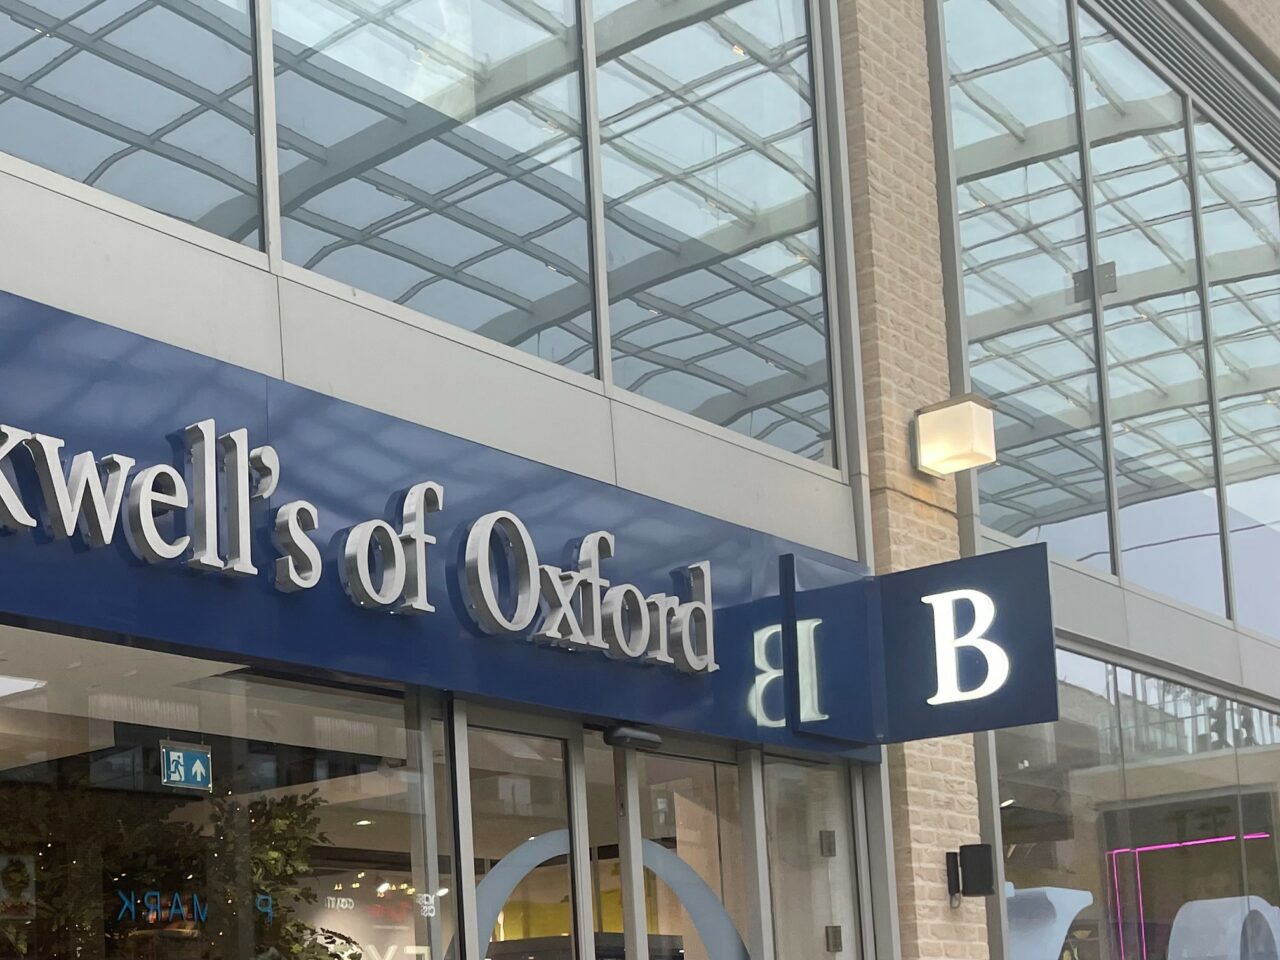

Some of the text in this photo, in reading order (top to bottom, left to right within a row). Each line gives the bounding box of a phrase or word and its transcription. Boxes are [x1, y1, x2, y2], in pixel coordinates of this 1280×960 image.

[344, 480, 444, 614] of
[463, 510, 720, 673] Oxford
[920, 588, 1010, 706] B
